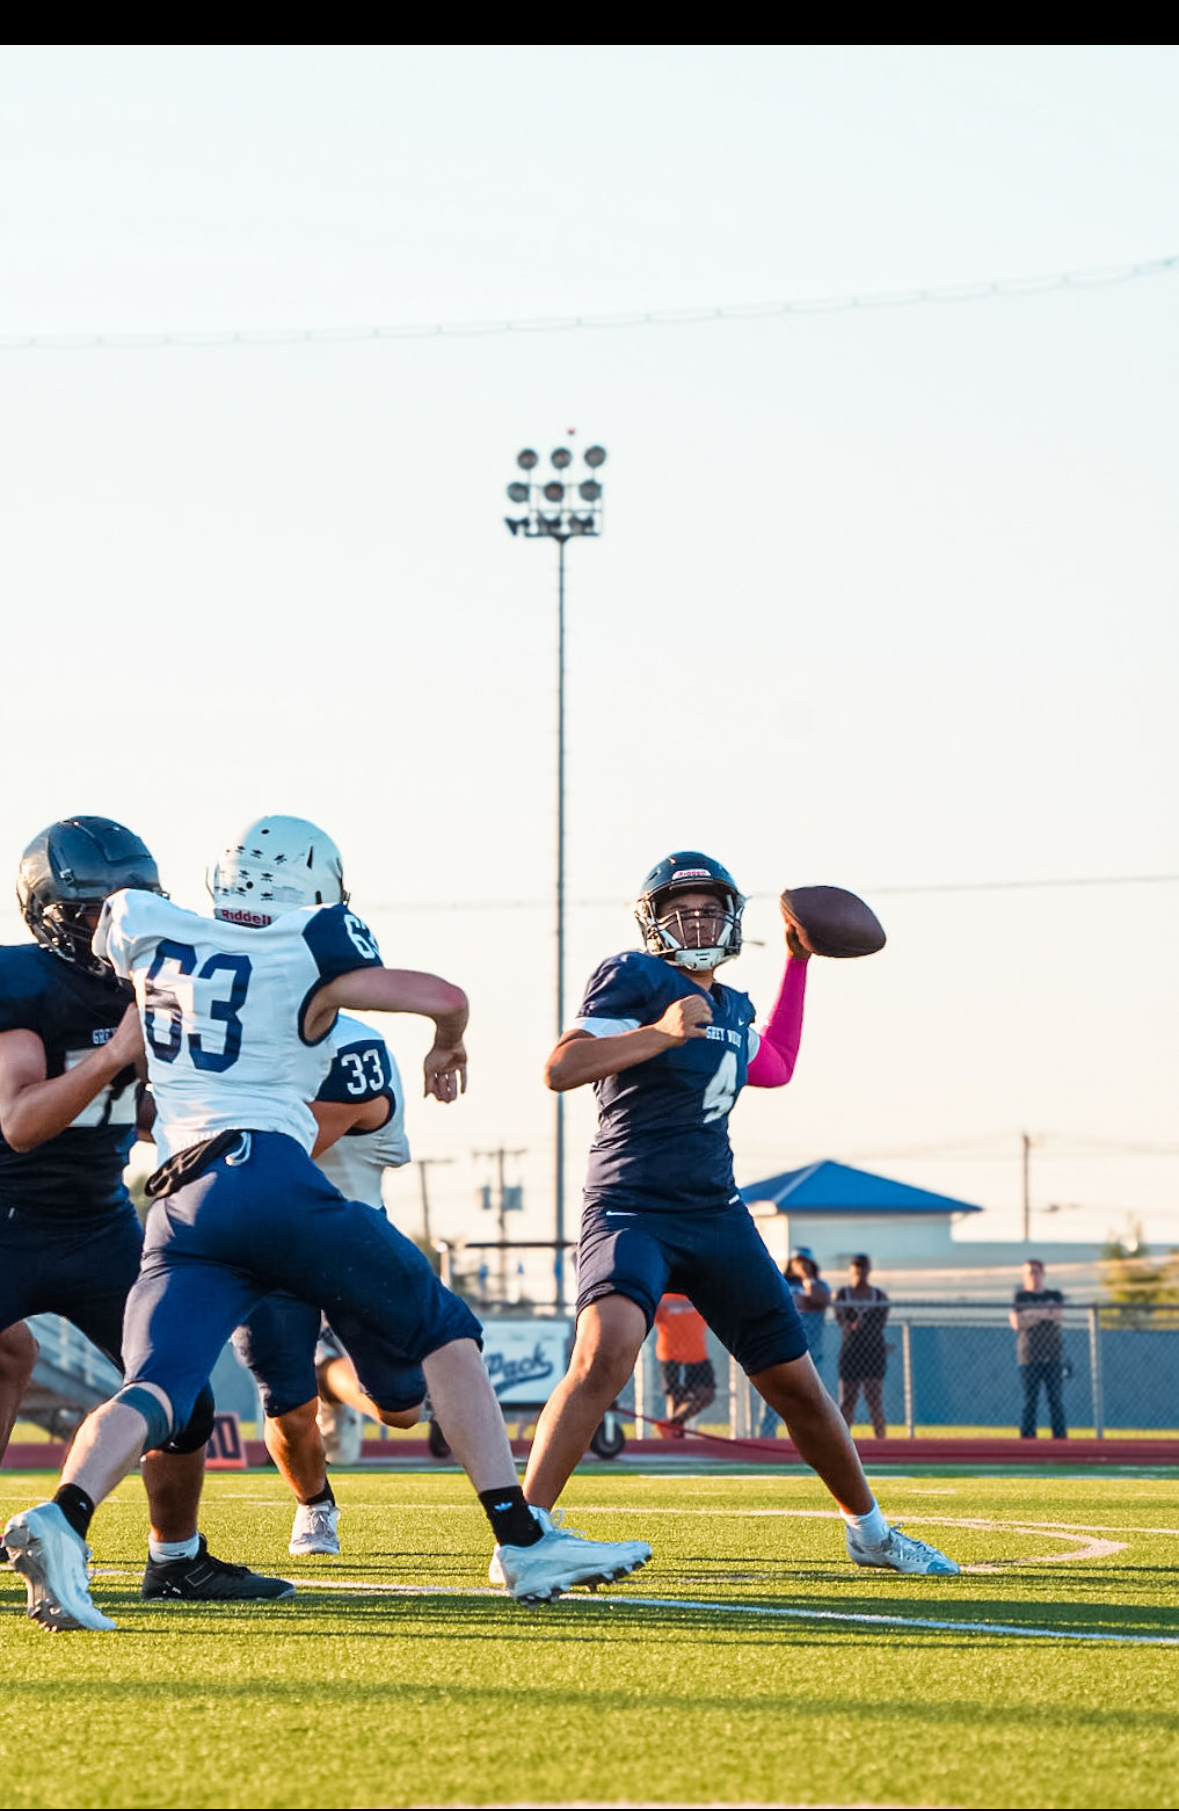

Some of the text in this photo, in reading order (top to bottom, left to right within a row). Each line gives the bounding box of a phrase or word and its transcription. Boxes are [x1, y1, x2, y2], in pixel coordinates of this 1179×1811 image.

[220, 907, 272, 926] Riddell
[144, 938, 253, 1073] 63
[341, 1048, 384, 1095] 33
[702, 1050, 737, 1124] 4
[206, 1415, 241, 1459] 0
